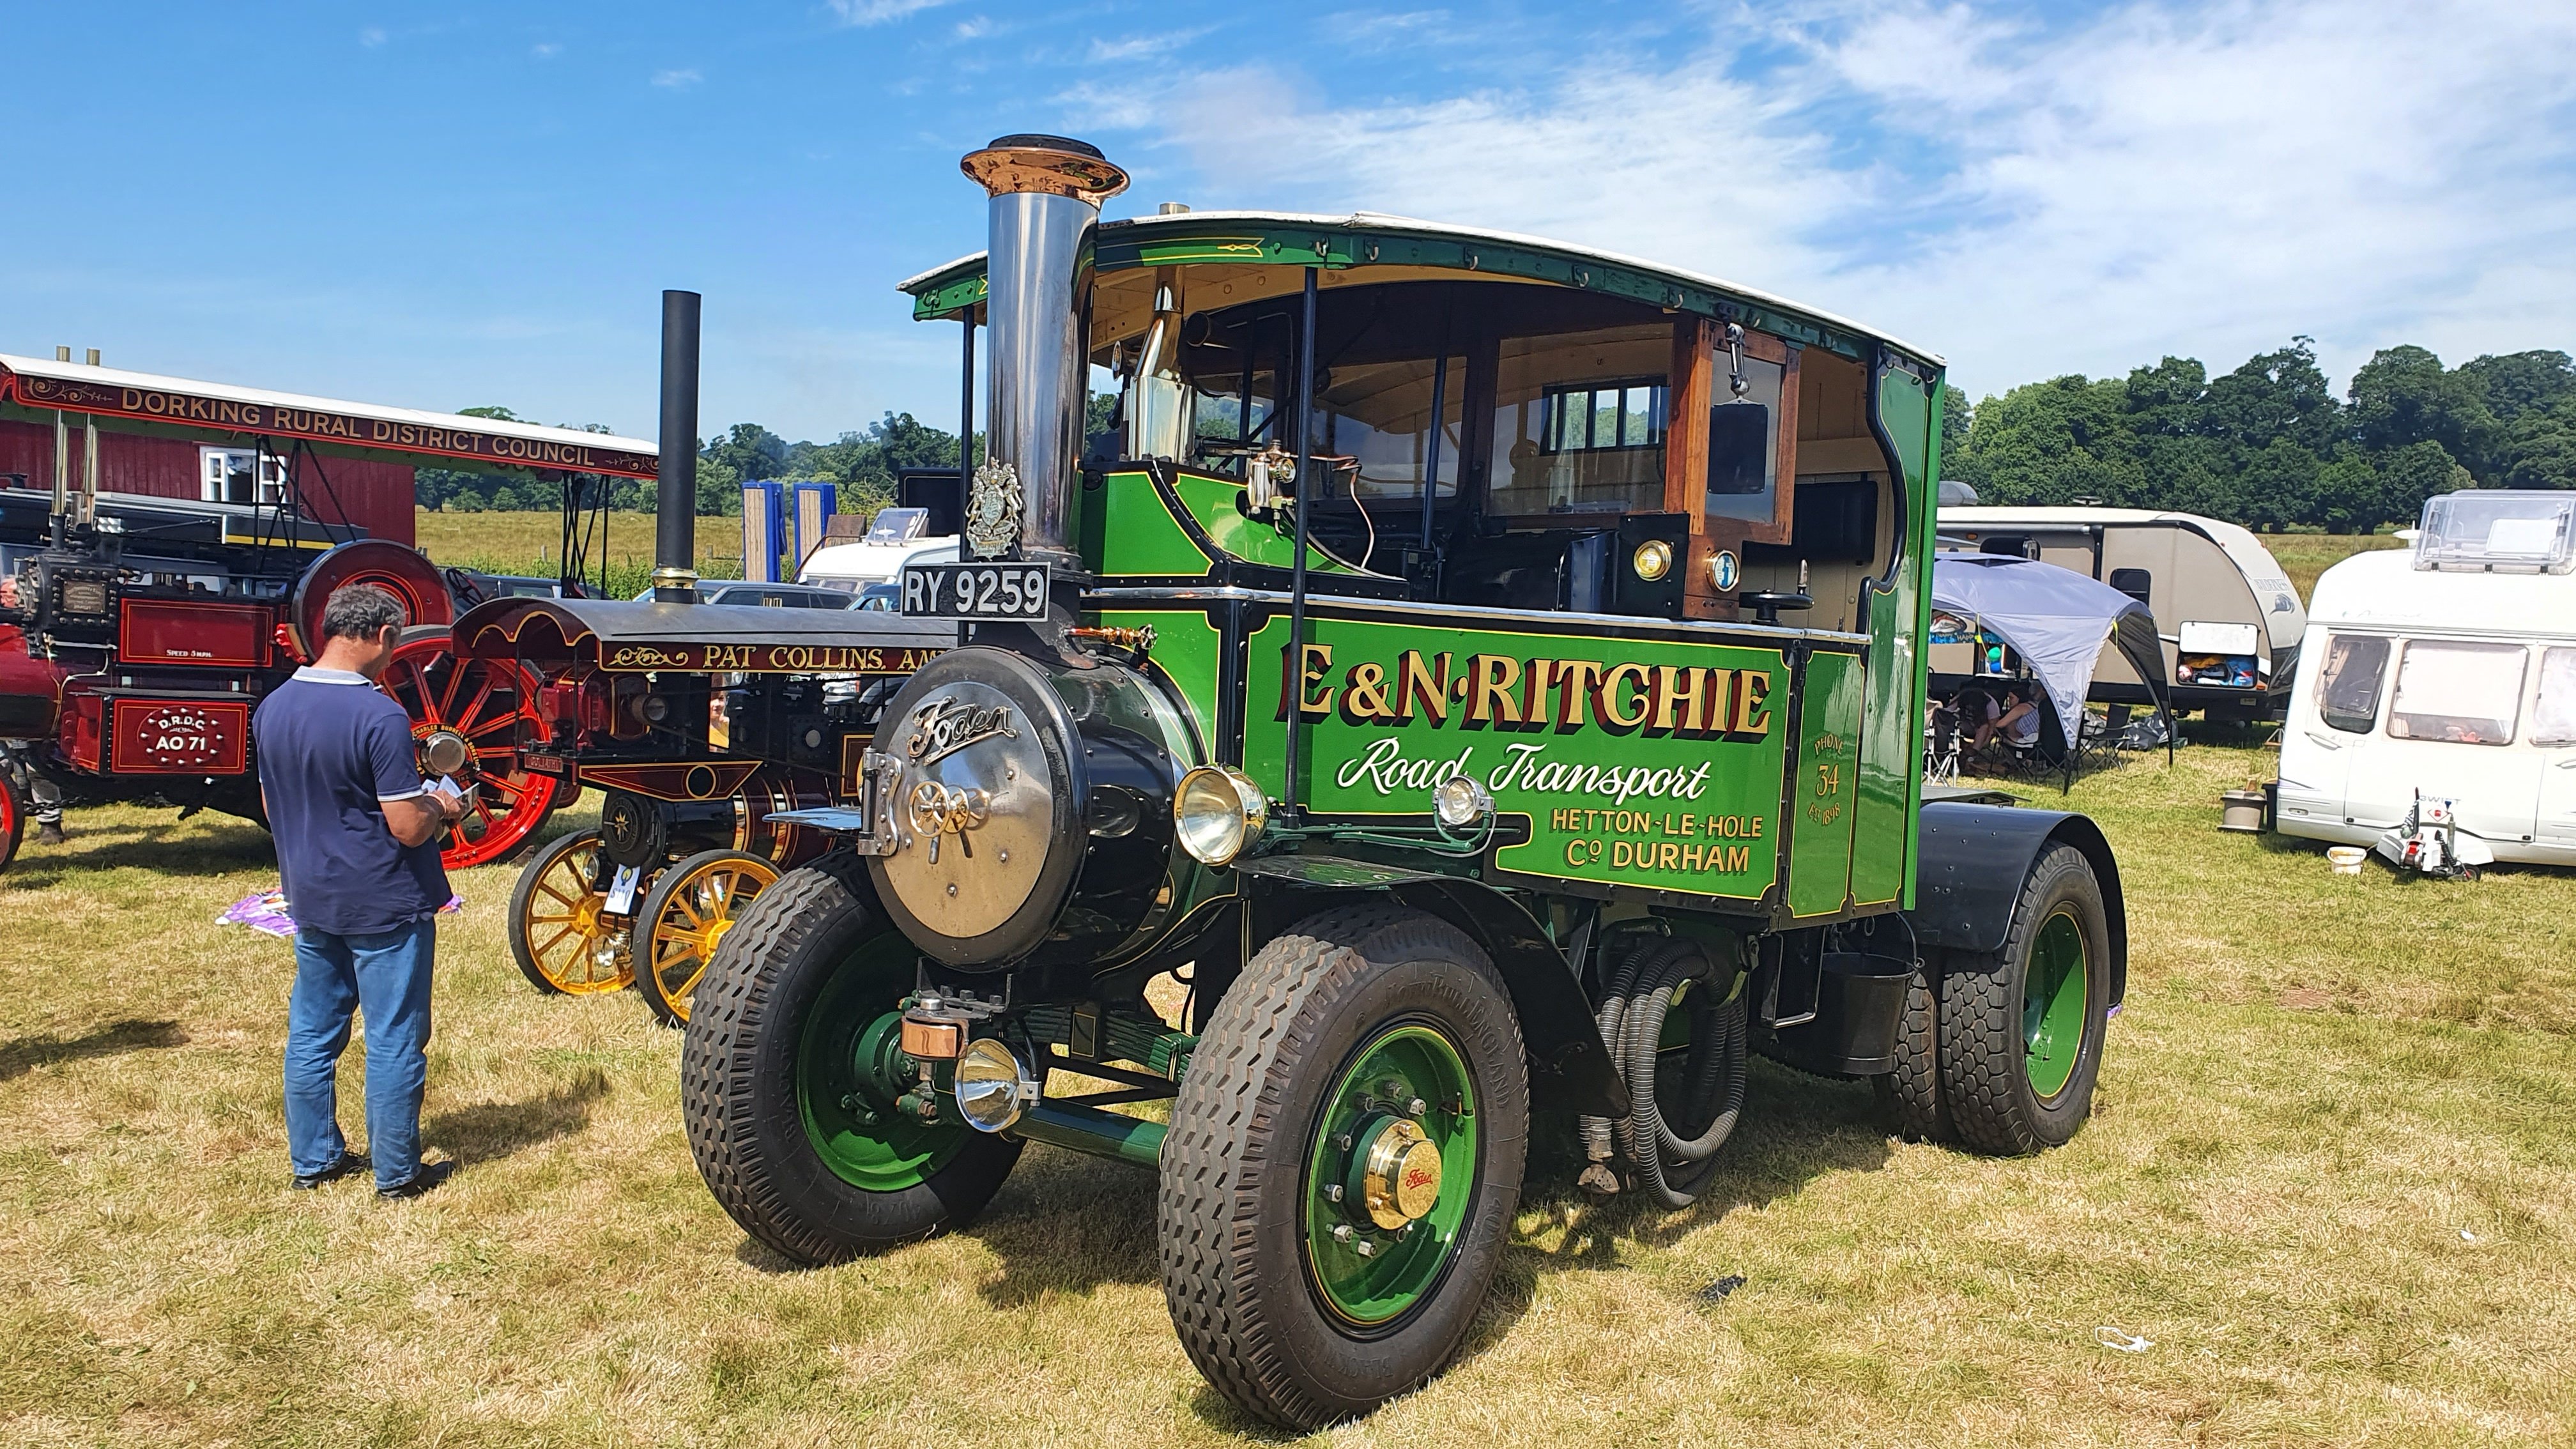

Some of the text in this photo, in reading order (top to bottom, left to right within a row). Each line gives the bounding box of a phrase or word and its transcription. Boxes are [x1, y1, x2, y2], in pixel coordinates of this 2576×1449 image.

[122, 388, 595, 466] DORKING RURAL DISTRICT COUNCIL
[903, 570, 1045, 615] RY 9259
[703, 645, 757, 669] PAT
[156, 735, 206, 751] AO 71
[907, 696, 1020, 766] Foden
[1814, 733, 1844, 756] PHONE
[1337, 736, 1712, 806] Road Transport
[1816, 764, 1839, 797] 34
[1808, 803, 1821, 822] EST
[1612, 841, 1751, 873] DURHAM
[1406, 1168, 1434, 1190] Foden
